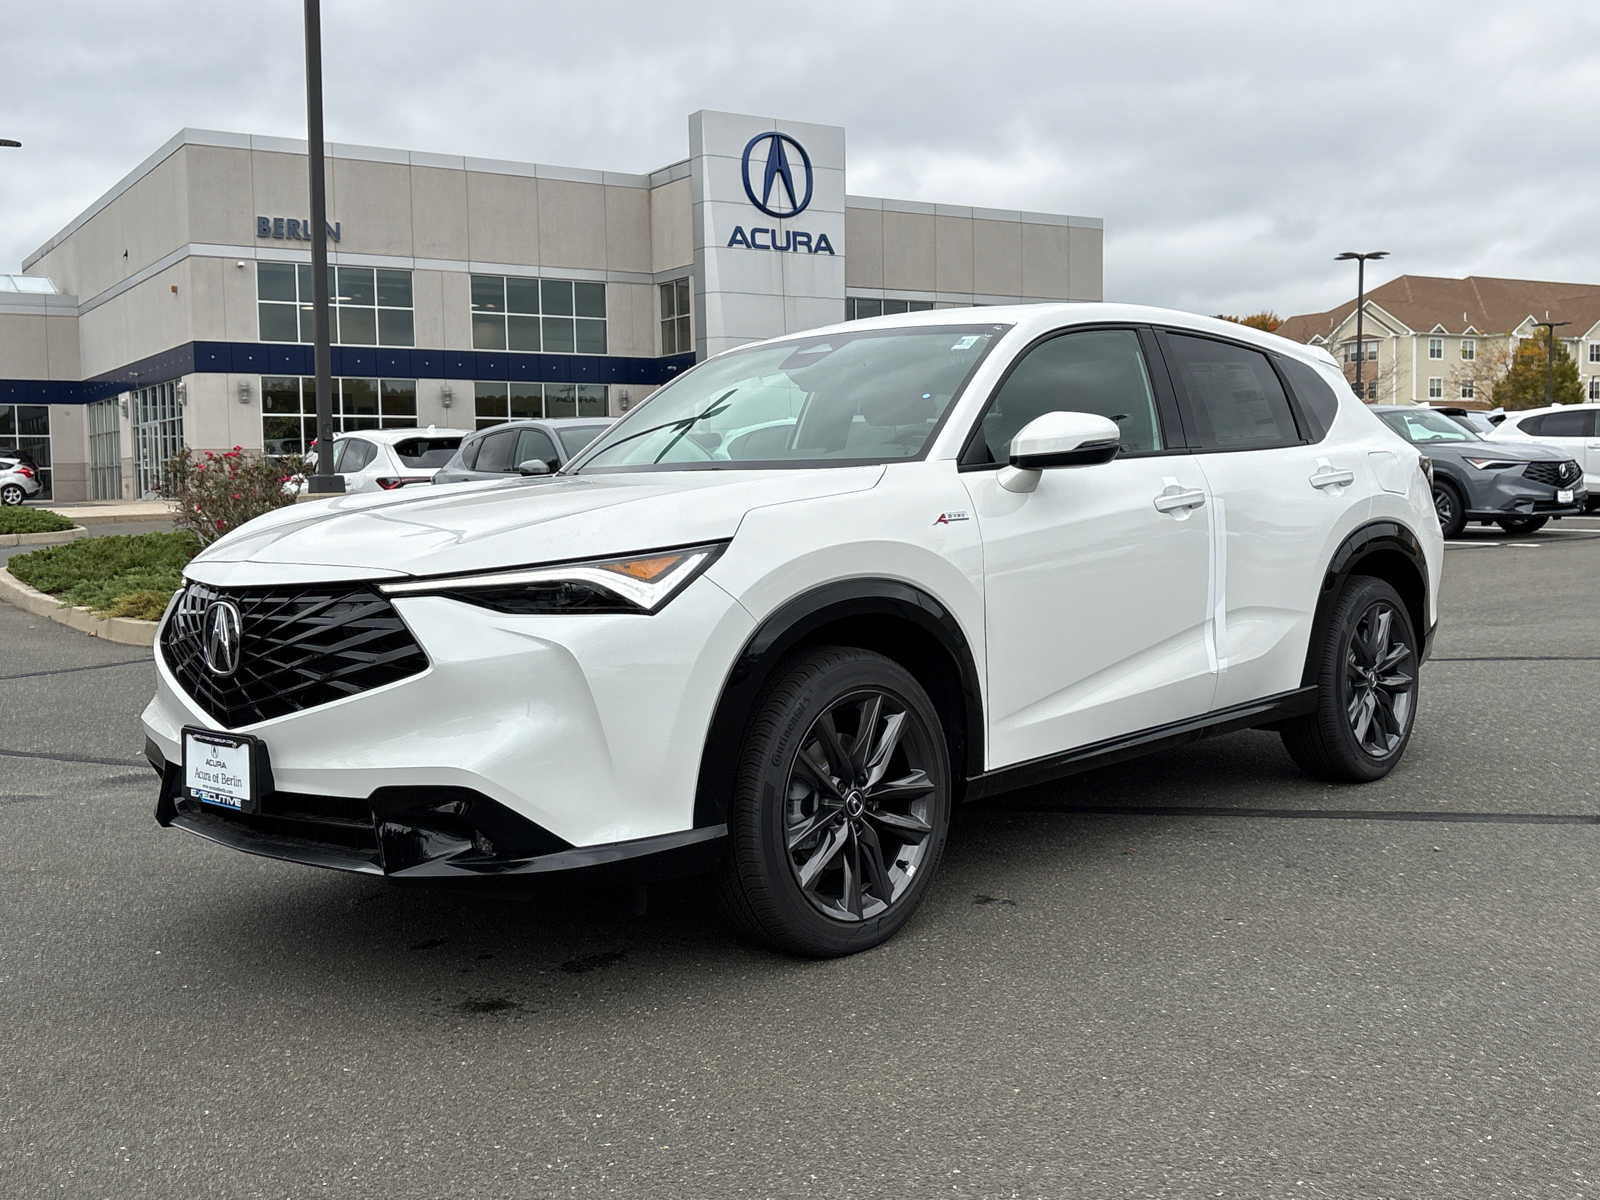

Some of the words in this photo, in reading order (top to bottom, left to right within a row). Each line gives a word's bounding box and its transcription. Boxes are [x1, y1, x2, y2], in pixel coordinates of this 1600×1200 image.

[257, 216, 341, 243] BERLN
[727, 225, 836, 255] ACURA
[771, 702, 807, 767] Continental
[205, 758, 227, 769] ACURA
[194, 767, 212, 782] Acura
[212, 772, 219, 783] of
[221, 772, 242, 787] Berlin
[190, 788, 242, 807] EXECUTIVE
